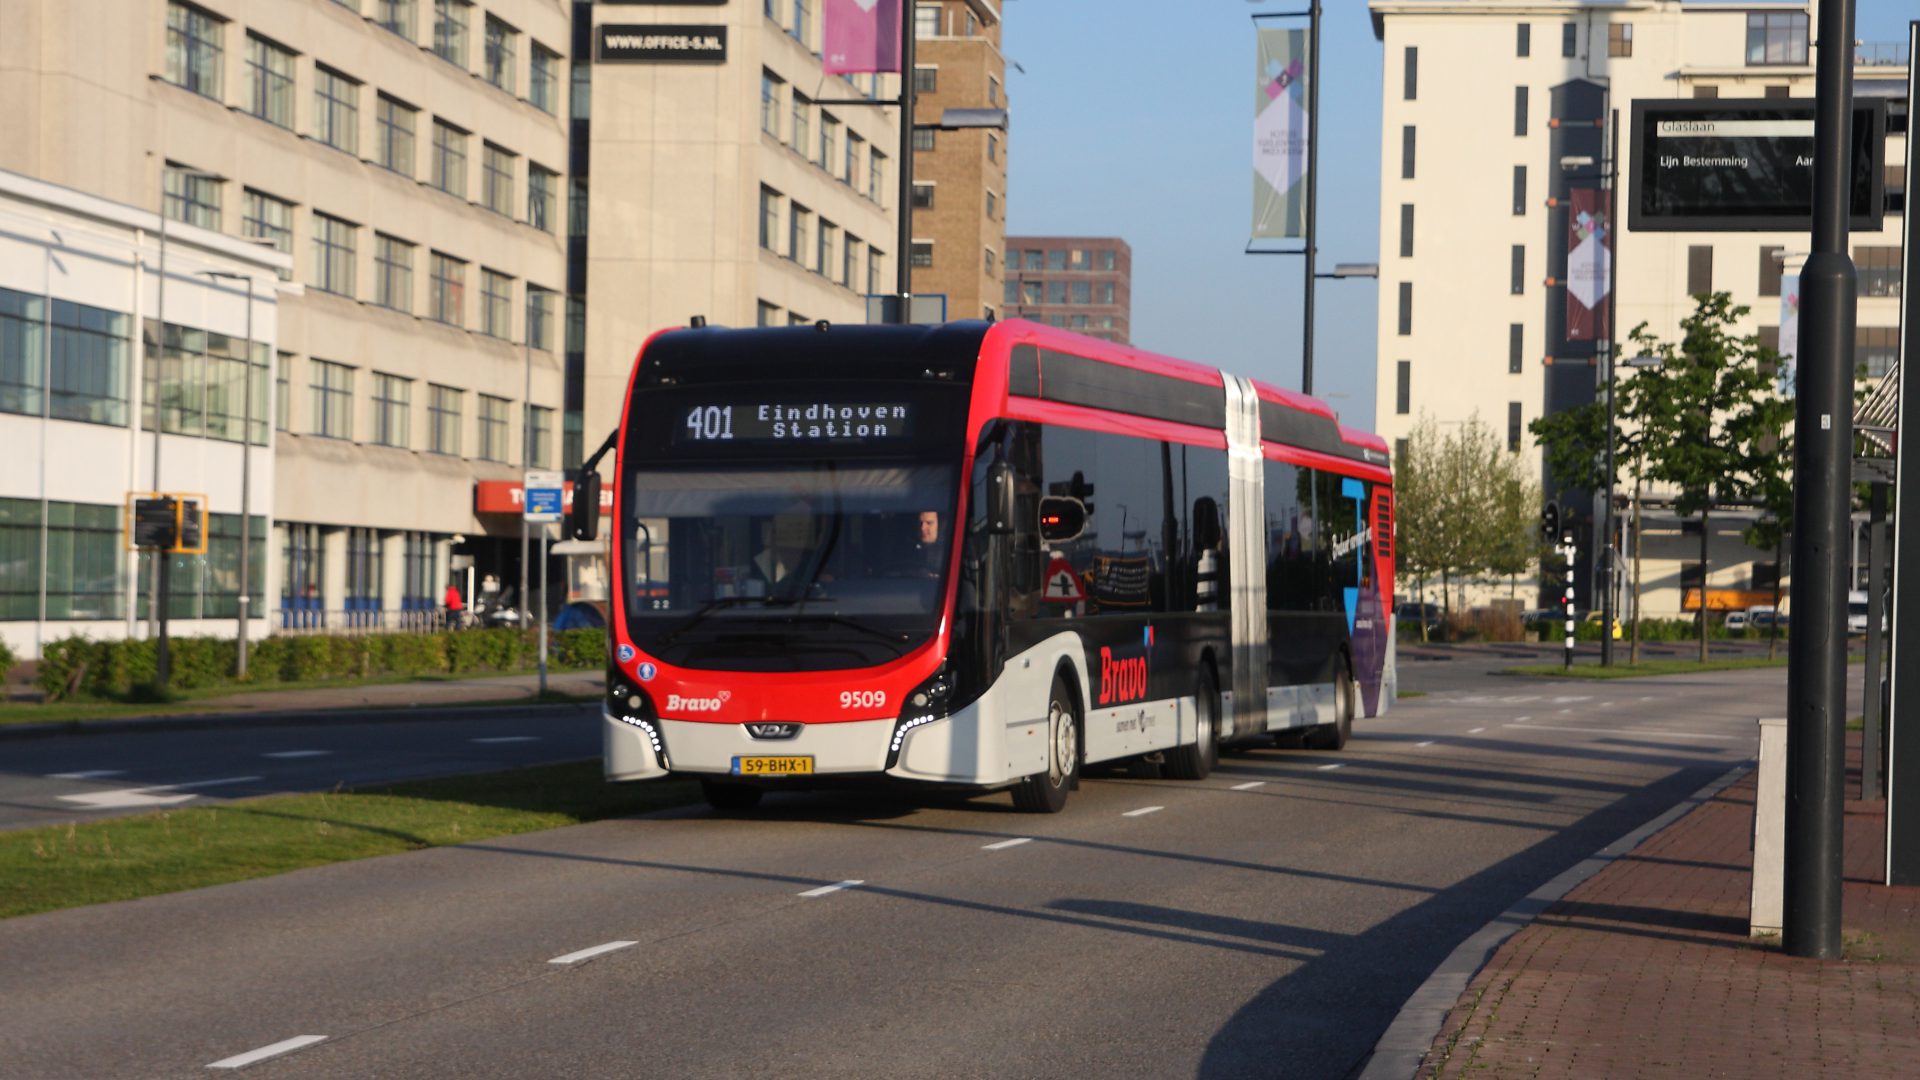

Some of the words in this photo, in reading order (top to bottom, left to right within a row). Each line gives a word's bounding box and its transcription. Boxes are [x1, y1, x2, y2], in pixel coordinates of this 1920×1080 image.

[605, 35, 722, 49] WWW.OFFICE-S.NL
[1662, 121, 1715, 133] Glaslaan
[1660, 155, 1679, 168] Lijn
[1683, 155, 1748, 169] Bestemming
[687, 406, 733, 439] 401
[758, 404, 906, 421] Eindhoven
[773, 422, 887, 438] Station
[1099, 645, 1147, 705] Bravo
[666, 694, 722, 711] Bravo
[840, 690, 886, 708] 9509
[752, 725, 793, 736] VDL
[746, 759, 807, 773] 59-BHX-1
